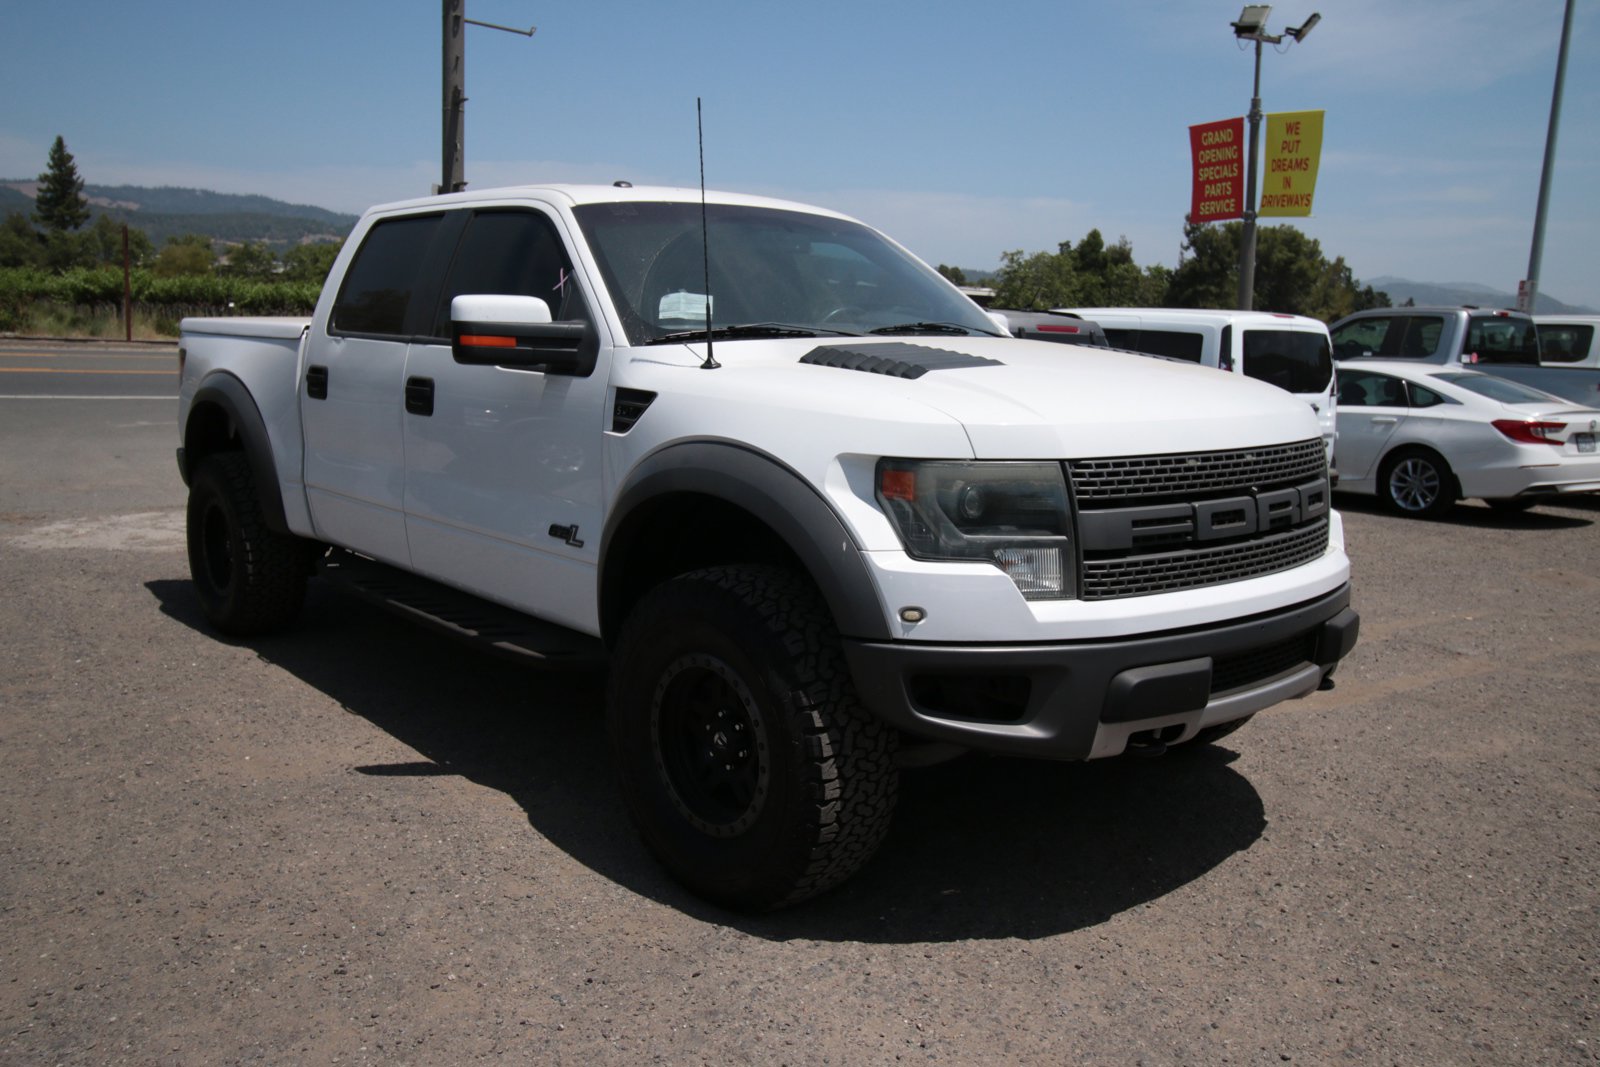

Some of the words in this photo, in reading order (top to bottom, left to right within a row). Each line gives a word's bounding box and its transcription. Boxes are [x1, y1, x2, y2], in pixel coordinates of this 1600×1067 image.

[1285, 121, 1302, 136] WE
[1201, 129, 1233, 146] GRAND
[1198, 146, 1238, 164] OPENING
[1281, 140, 1301, 154] PUT
[1198, 163, 1239, 181] SPECIALS
[1271, 157, 1310, 173] DREAMS
[1204, 181, 1232, 198] PARTS
[1282, 176, 1292, 189] IN
[1199, 198, 1236, 215] SERVICE
[1261, 193, 1312, 208] DRIVEWAYS
[1079, 478, 1329, 550] FORD
